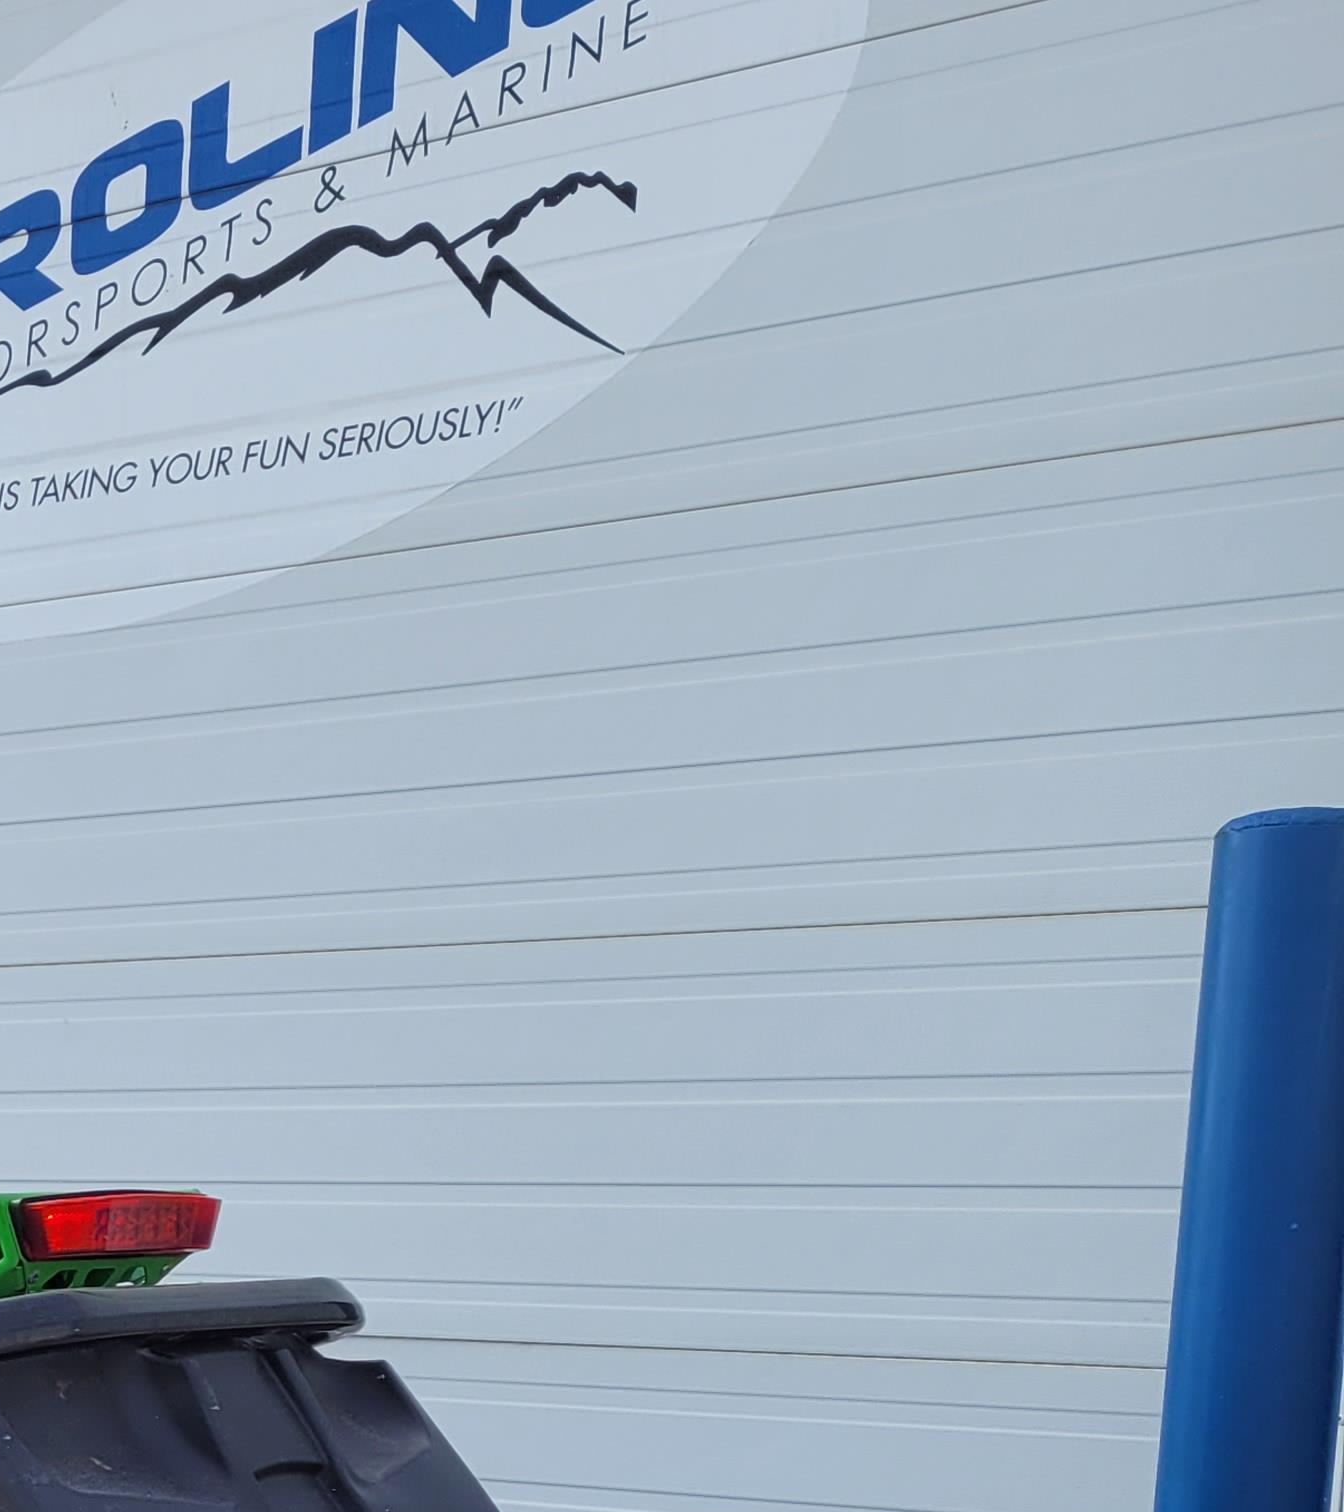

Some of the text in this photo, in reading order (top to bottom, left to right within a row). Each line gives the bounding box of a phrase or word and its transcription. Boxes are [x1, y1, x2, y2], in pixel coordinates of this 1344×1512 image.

[312, 165, 346, 214] &
[386, 0, 650, 178] MARINE
[30, 461, 138, 507] TAKING
[149, 445, 233, 488] YOUR
[242, 431, 311, 474] FUN
